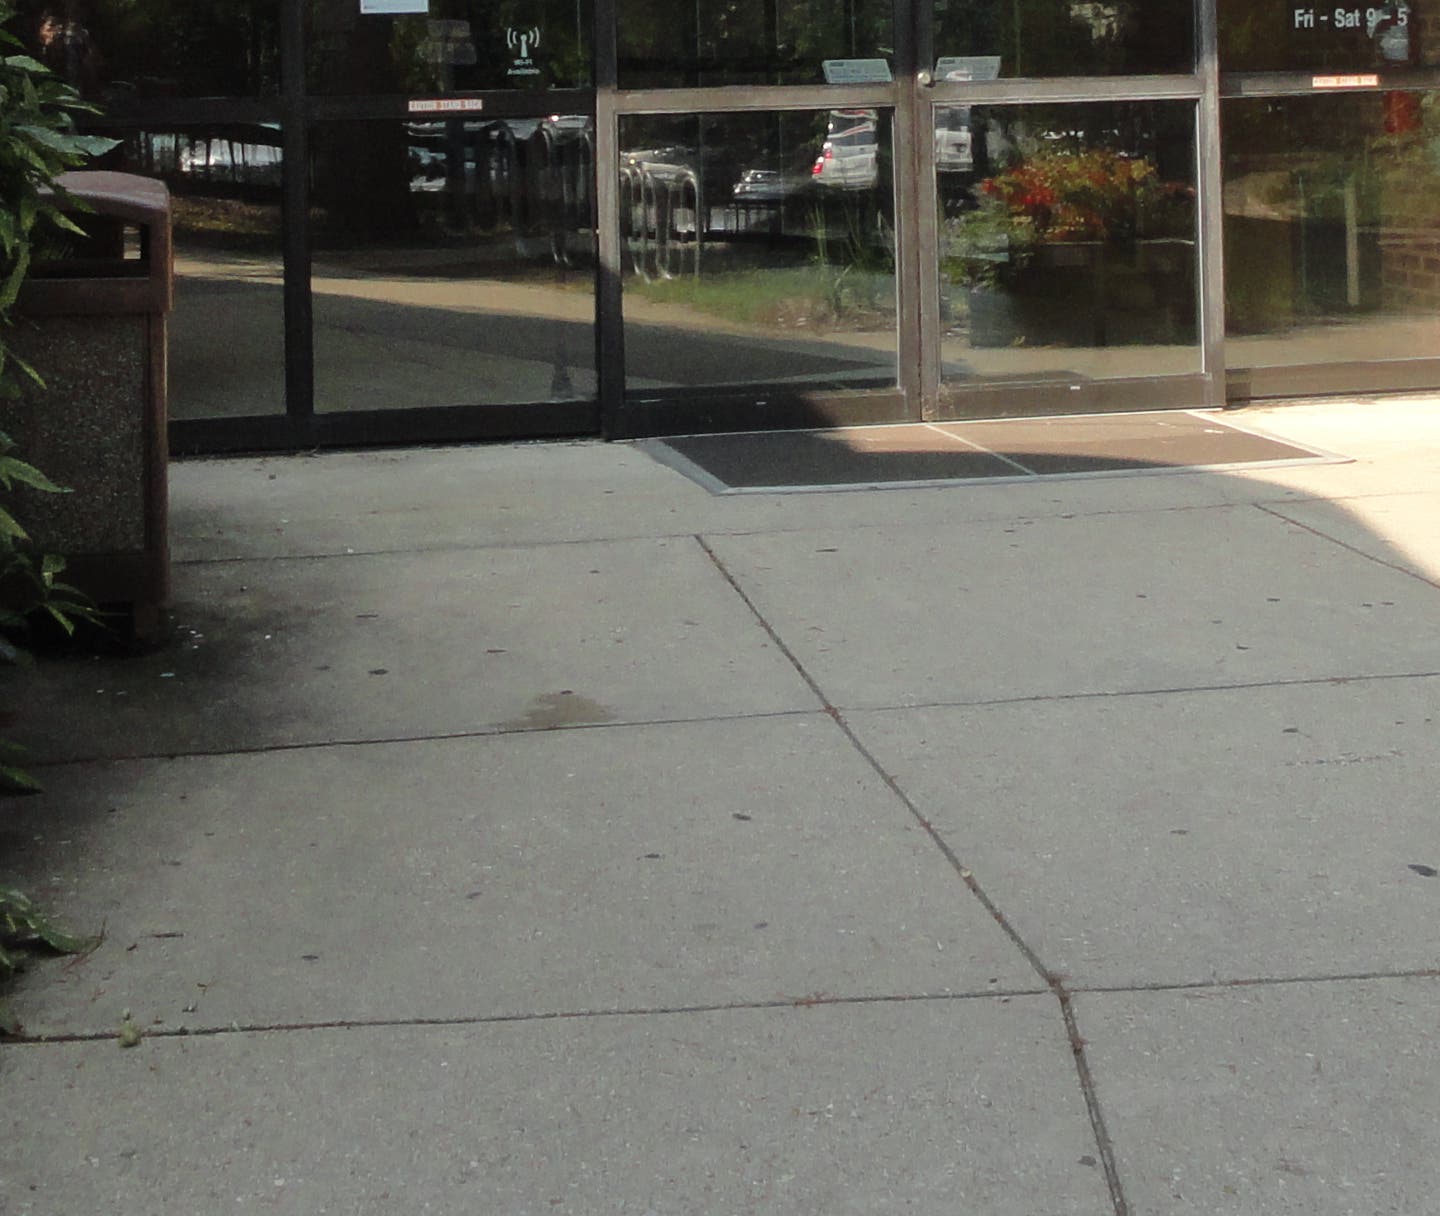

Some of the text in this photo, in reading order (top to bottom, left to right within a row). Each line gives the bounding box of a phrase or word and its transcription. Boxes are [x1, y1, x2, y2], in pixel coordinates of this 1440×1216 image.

[1293, 9, 1315, 29] Fri
[1333, 7, 1361, 28] Sat
[1365, 7, 1377, 27] 9
[1396, 7, 1408, 27] 5
